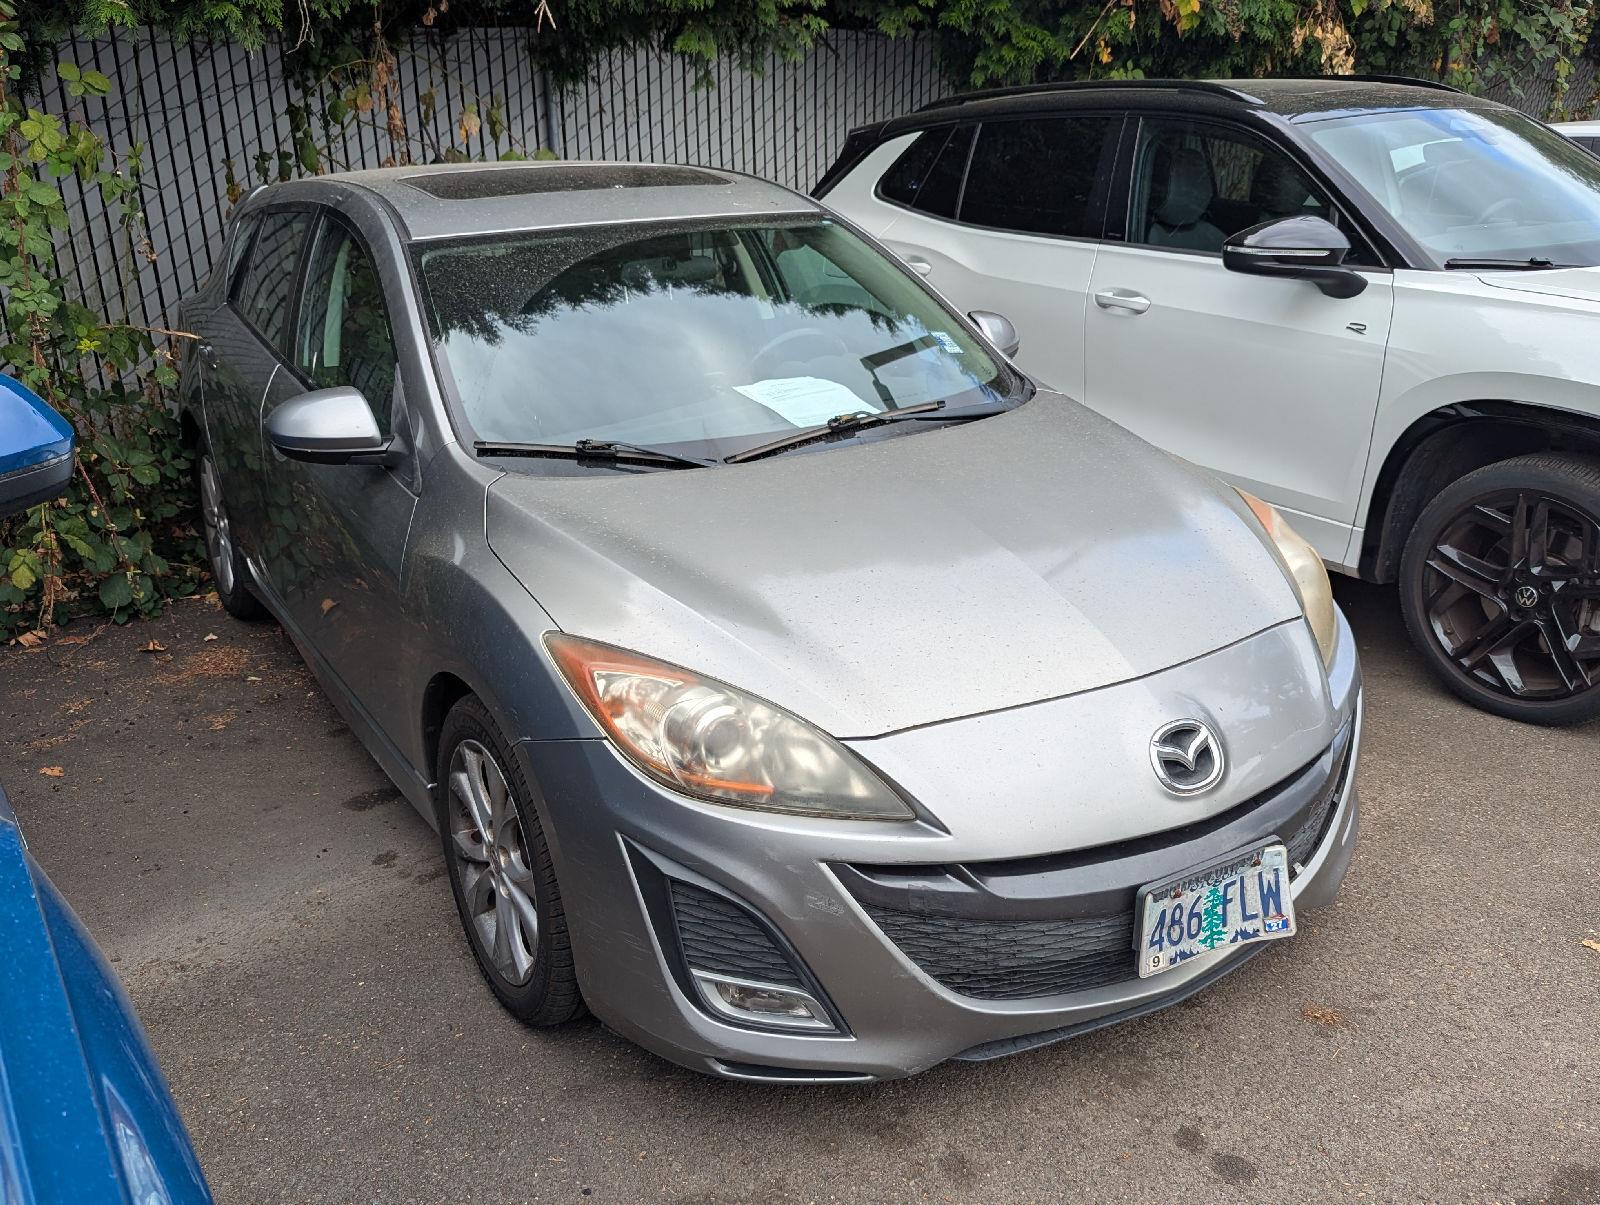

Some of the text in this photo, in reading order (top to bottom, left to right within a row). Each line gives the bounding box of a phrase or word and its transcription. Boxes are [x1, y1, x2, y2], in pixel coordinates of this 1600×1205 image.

[1518, 586, 1537, 607] VW
[1149, 868, 1282, 952] 486 FLW
[1152, 956, 1161, 968] 9
